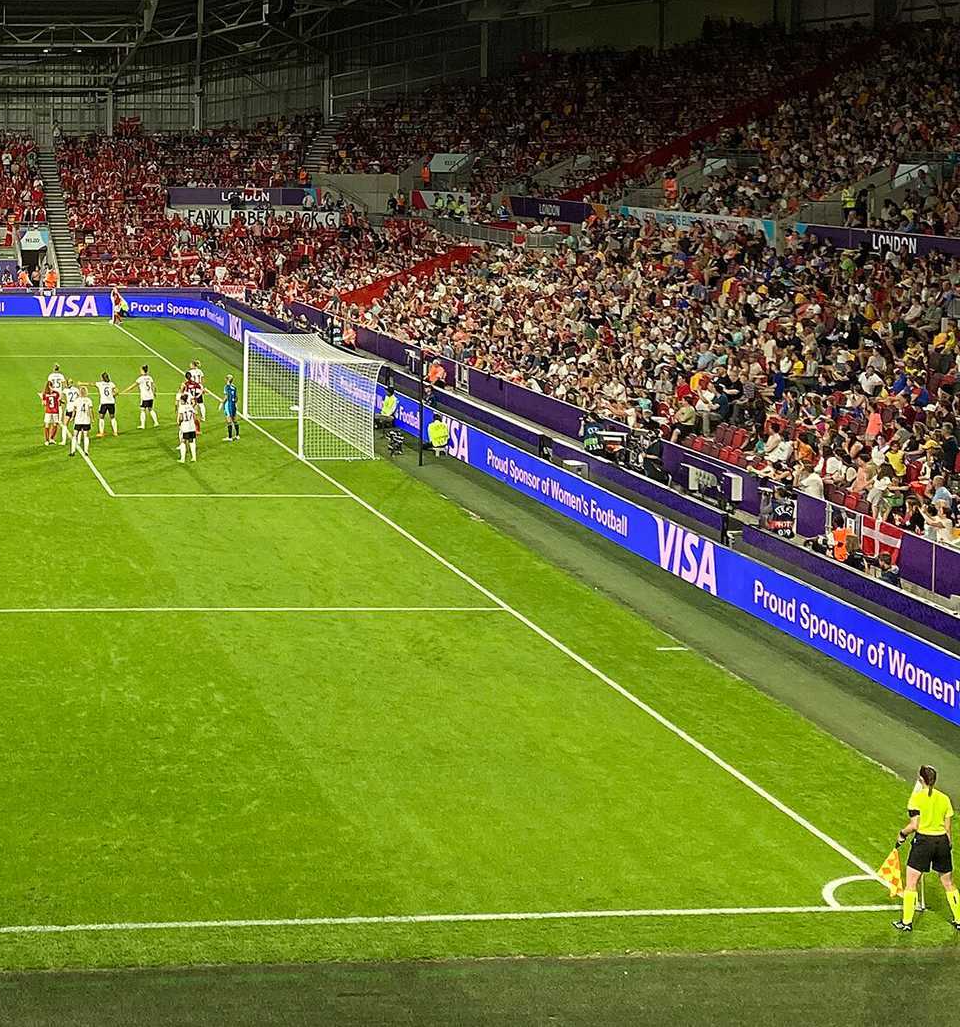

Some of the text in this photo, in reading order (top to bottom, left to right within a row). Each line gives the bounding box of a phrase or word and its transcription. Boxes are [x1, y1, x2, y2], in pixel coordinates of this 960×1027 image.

[221, 192, 270, 202] LODON
[34, 296, 98, 317] VISA
[167, 303, 200, 316] Sponsor
[487, 447, 628, 537] Proud Sponsor of Women's Football
[652, 513, 718, 596] VISA
[753, 579, 796, 623] Proud
[799, 602, 864, 657] Sponsor
[867, 642, 885, 669] of
